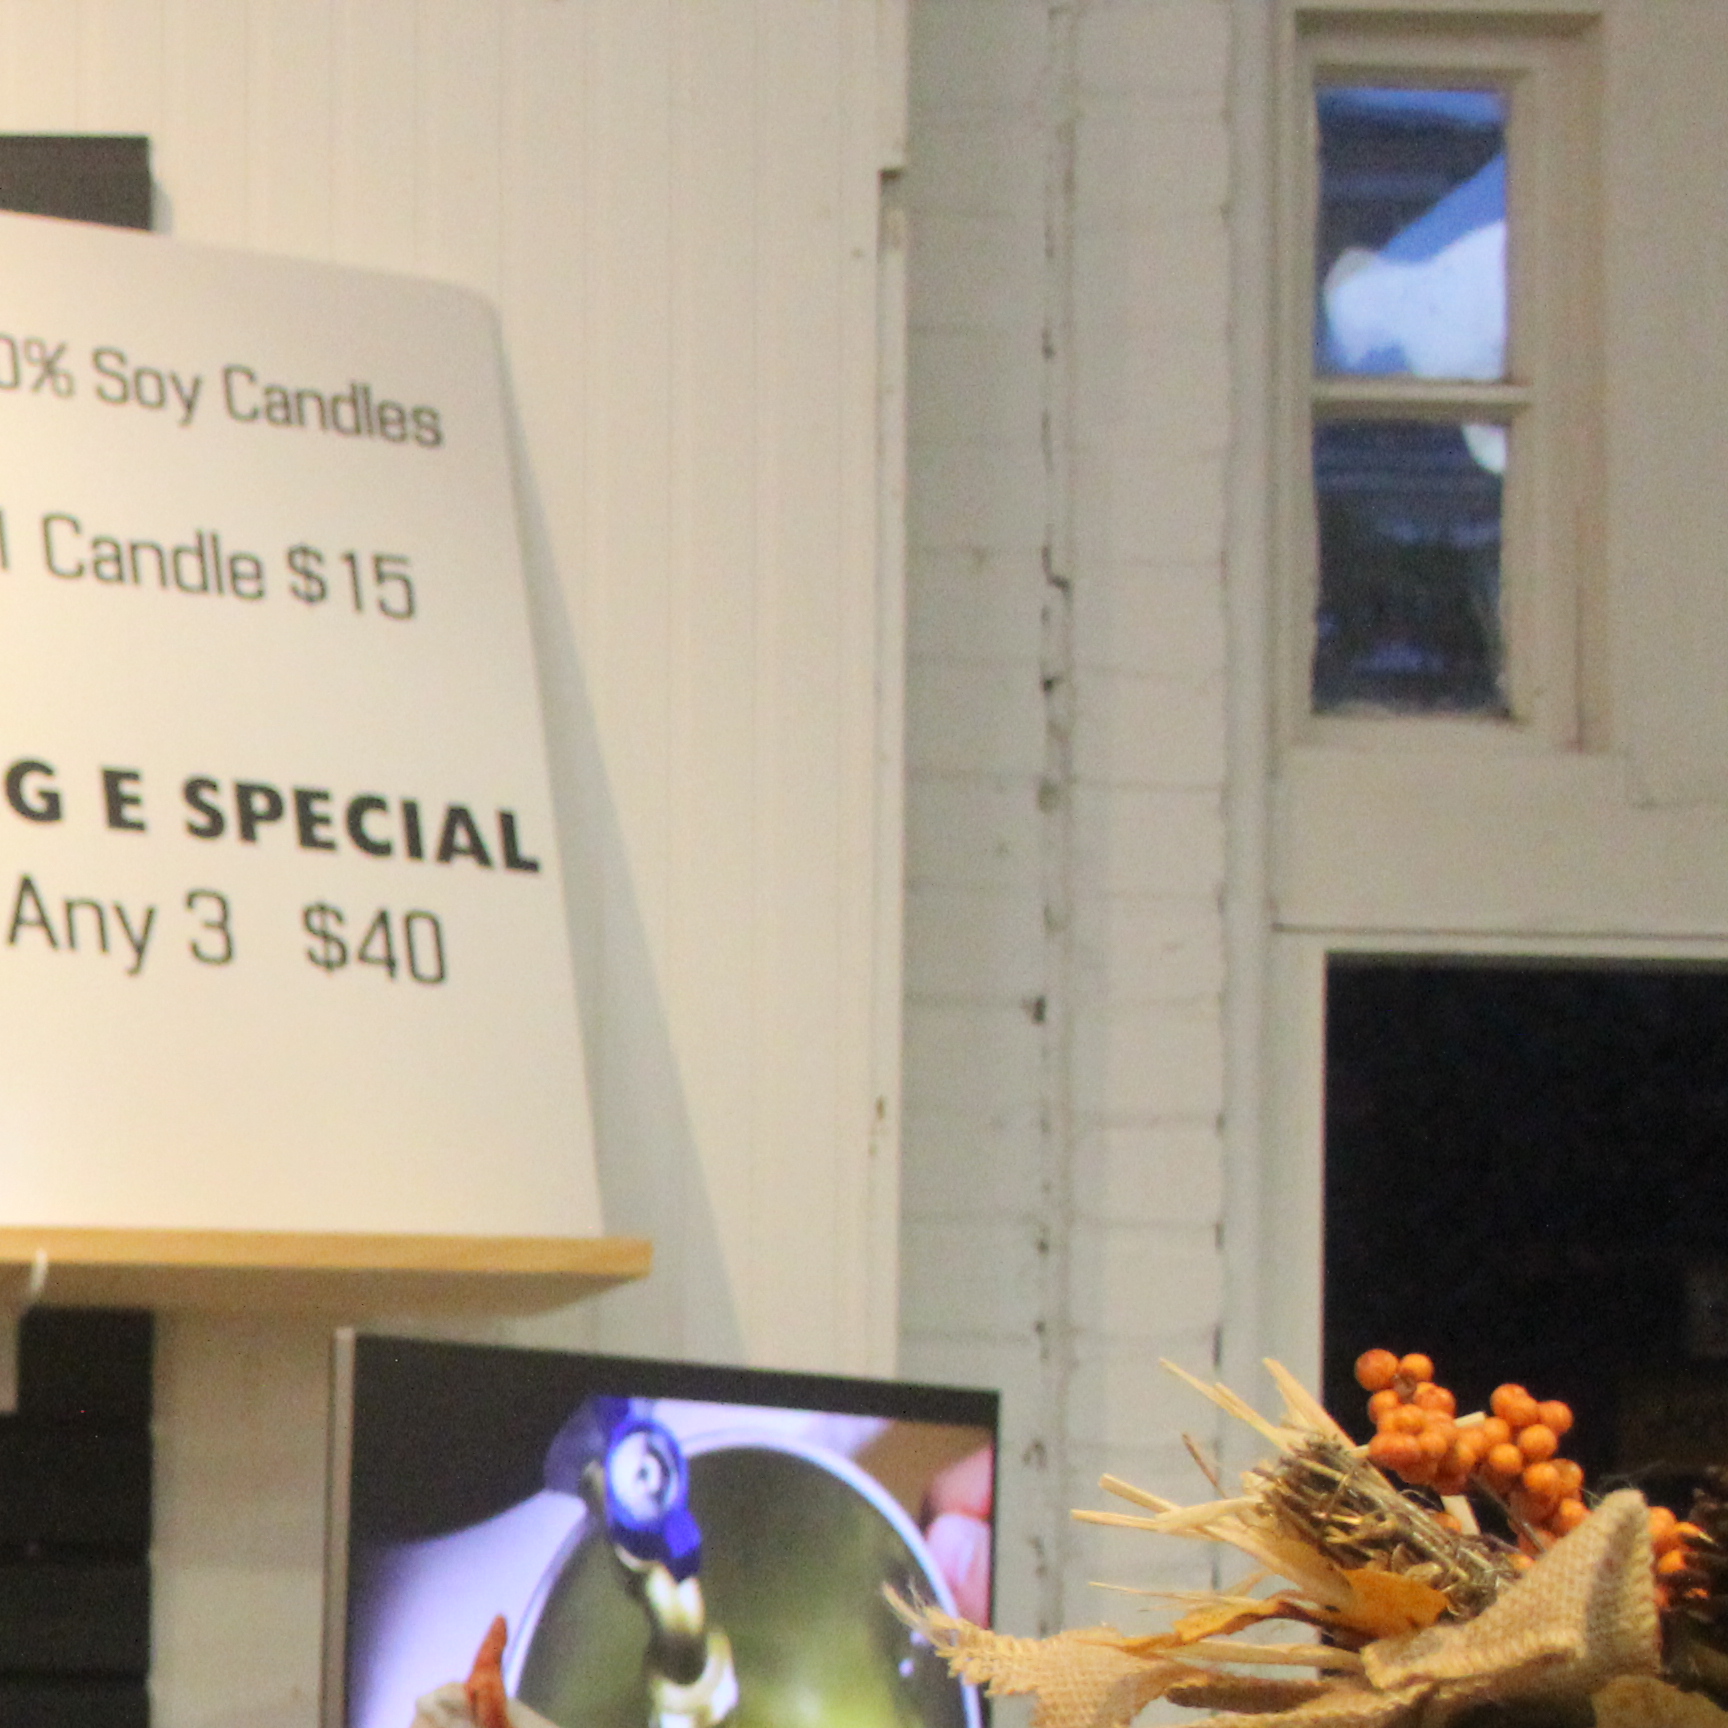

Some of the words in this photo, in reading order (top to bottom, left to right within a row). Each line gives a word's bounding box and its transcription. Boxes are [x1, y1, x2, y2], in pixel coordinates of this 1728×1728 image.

[91, 346, 203, 428] Soy
[222, 364, 445, 449] Candles
[41, 512, 267, 603] Candle
[286, 543, 419, 622] $15
[99, 766, 148, 835] E
[181, 775, 541, 875] SPECIAL
[5, 873, 157, 977] Any
[186, 888, 235, 967] 3
[303, 901, 448, 987] $40
